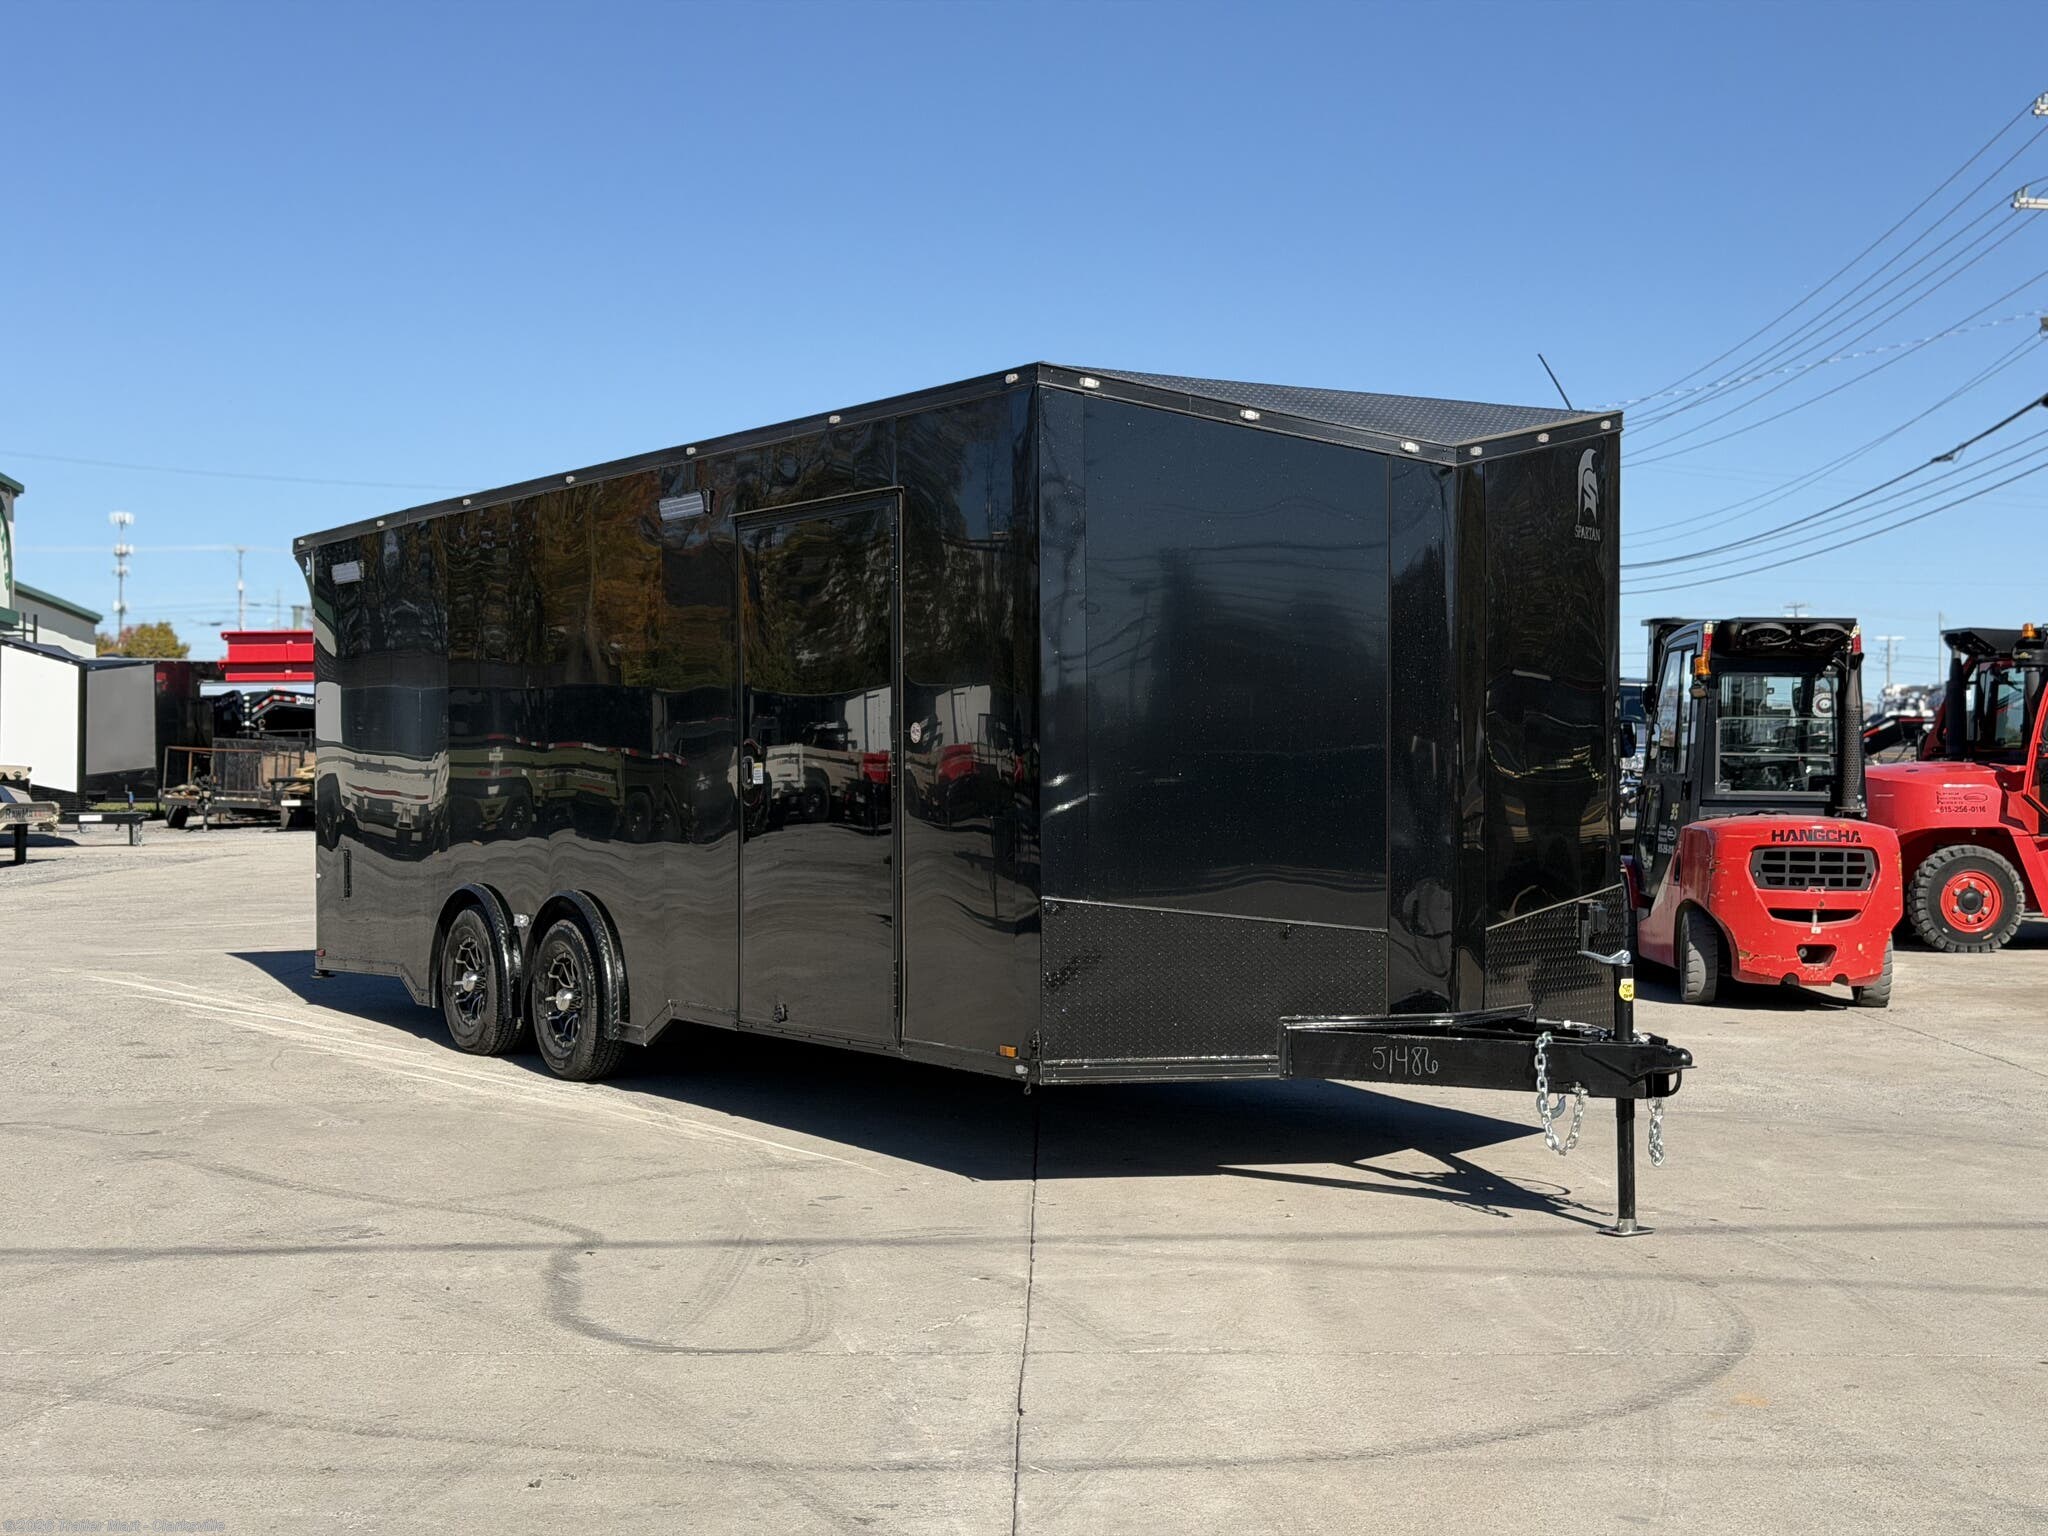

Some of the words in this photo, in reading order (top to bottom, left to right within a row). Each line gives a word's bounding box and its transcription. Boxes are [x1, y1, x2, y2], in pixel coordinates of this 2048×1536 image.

[1575, 524, 1601, 541] SPARTAN
[1771, 829, 1862, 843] HANGCHA
[1372, 1045, 1439, 1076] 51486
